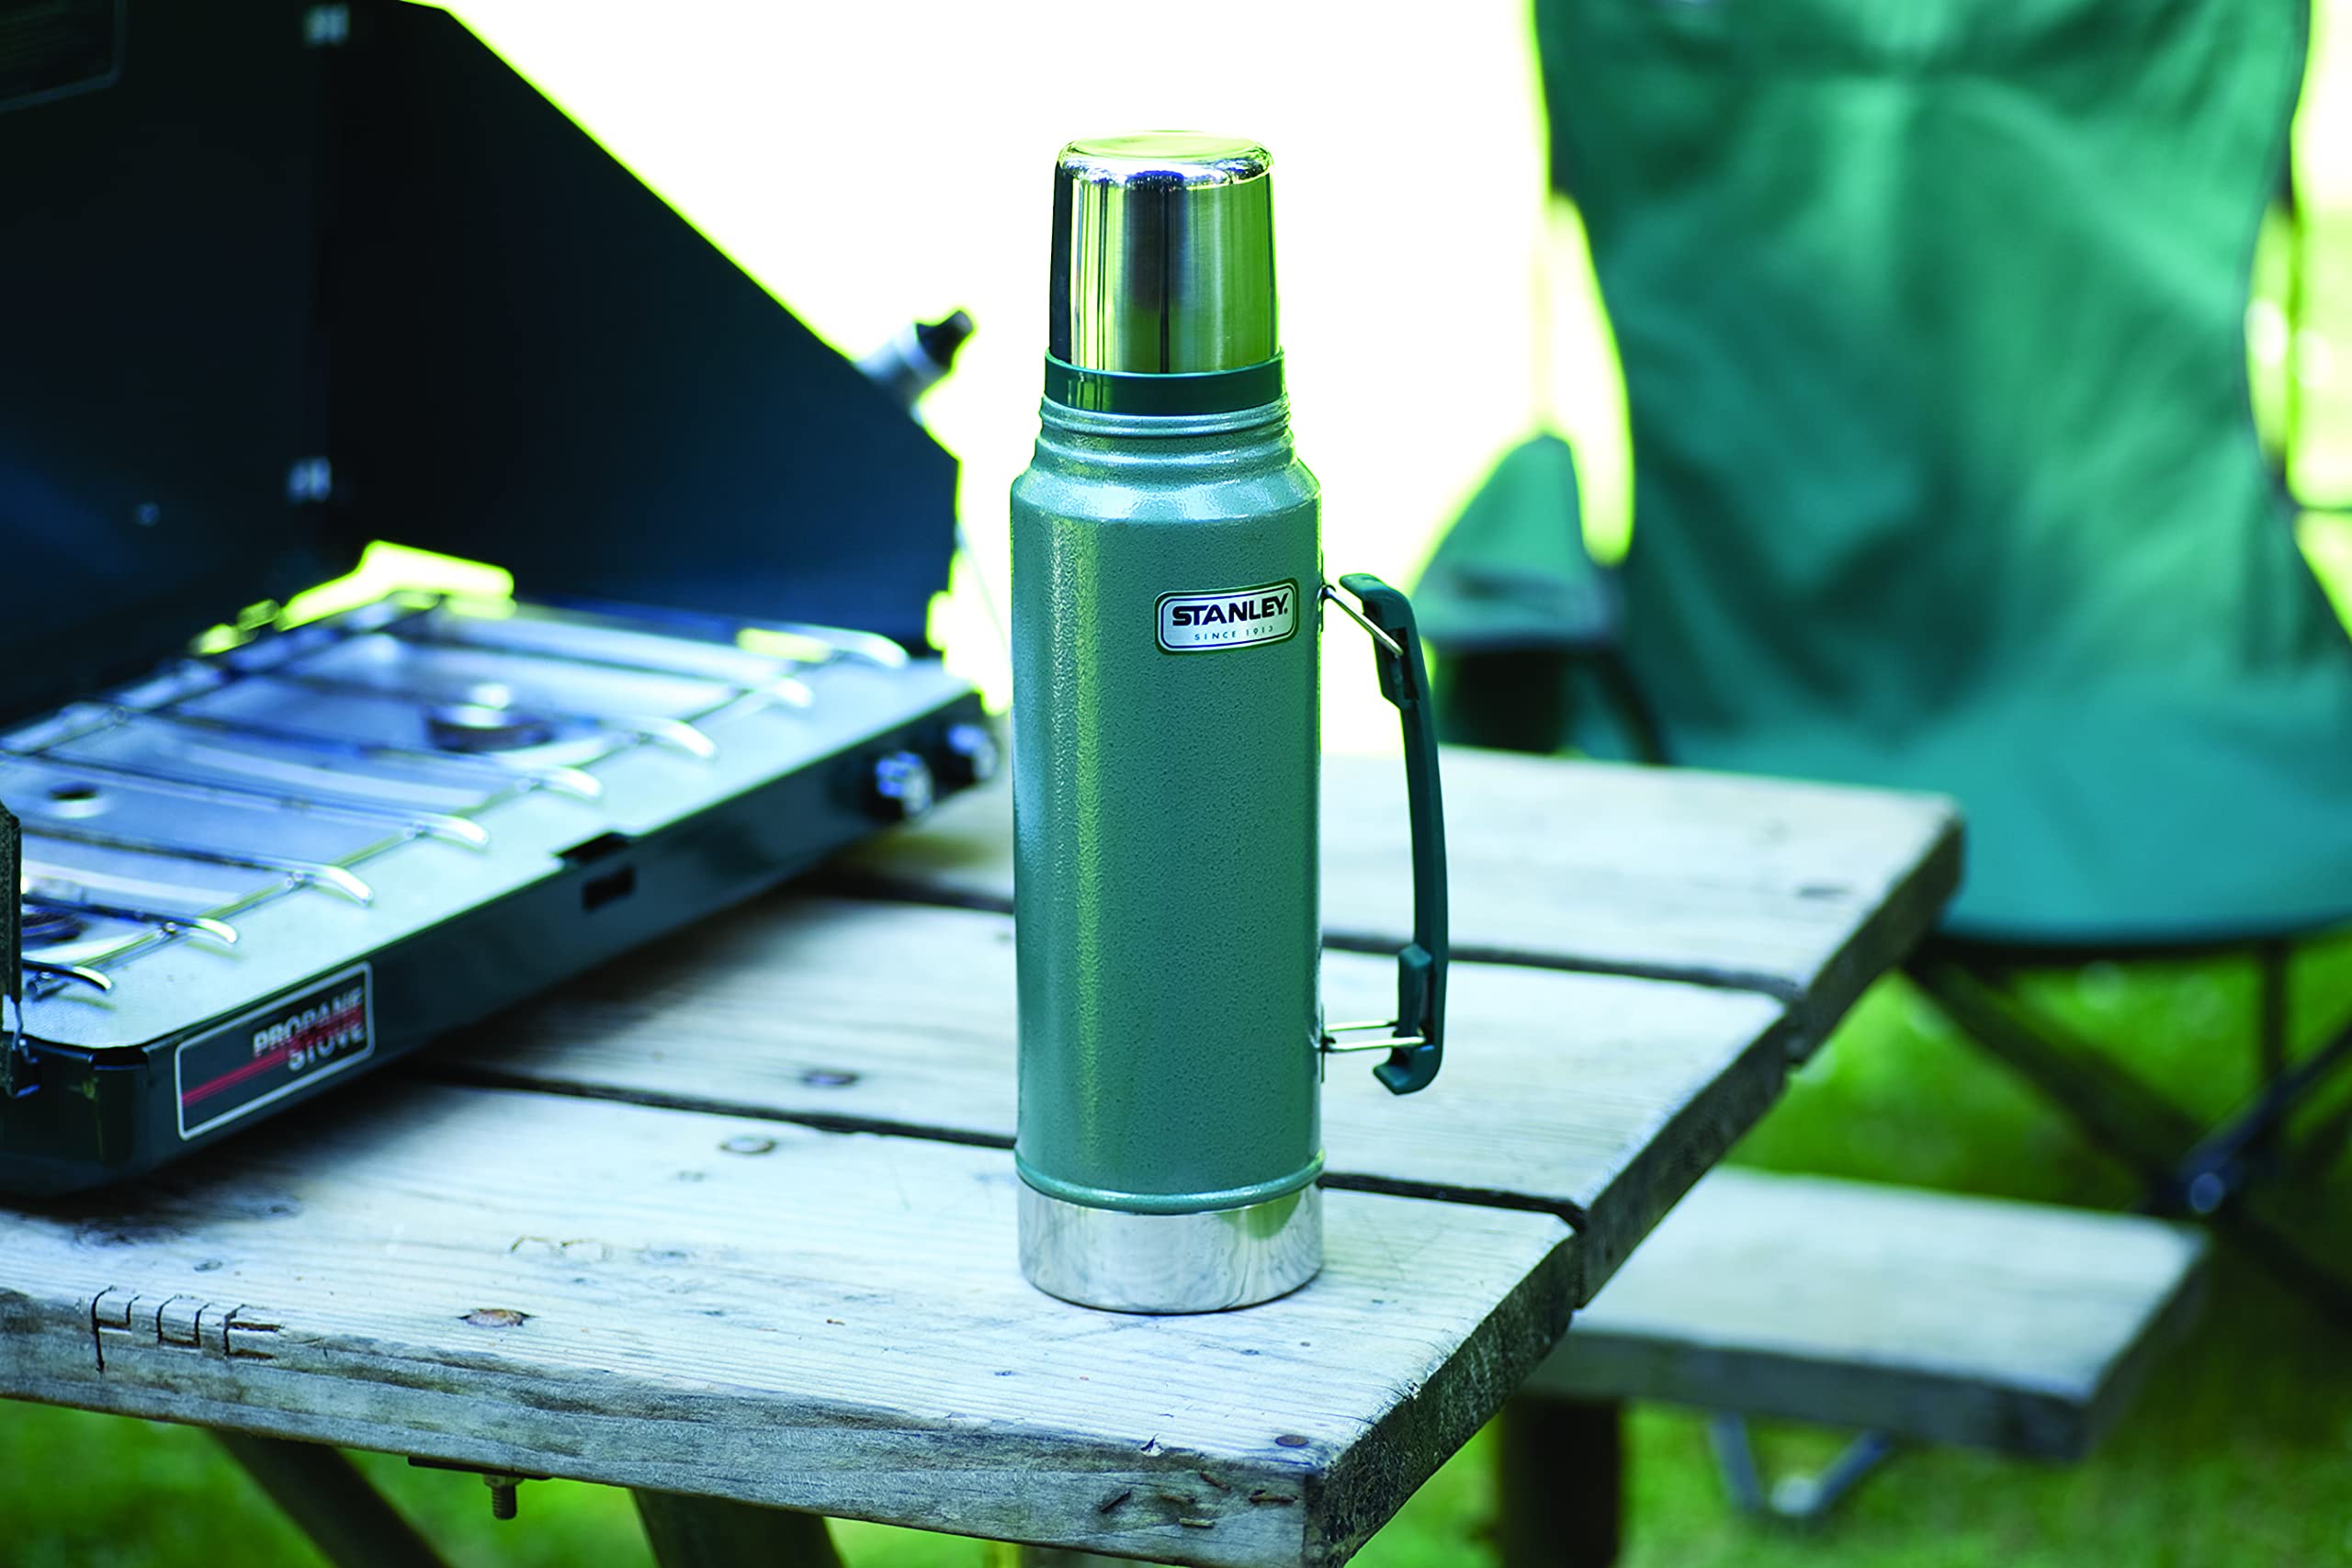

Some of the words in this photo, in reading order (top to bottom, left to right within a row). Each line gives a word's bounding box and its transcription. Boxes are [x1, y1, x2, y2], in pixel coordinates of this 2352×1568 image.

[1194, 629, 1236, 640] SINCE
[1246, 626, 1273, 636] 1913
[253, 987, 364, 1057] PROPANE
